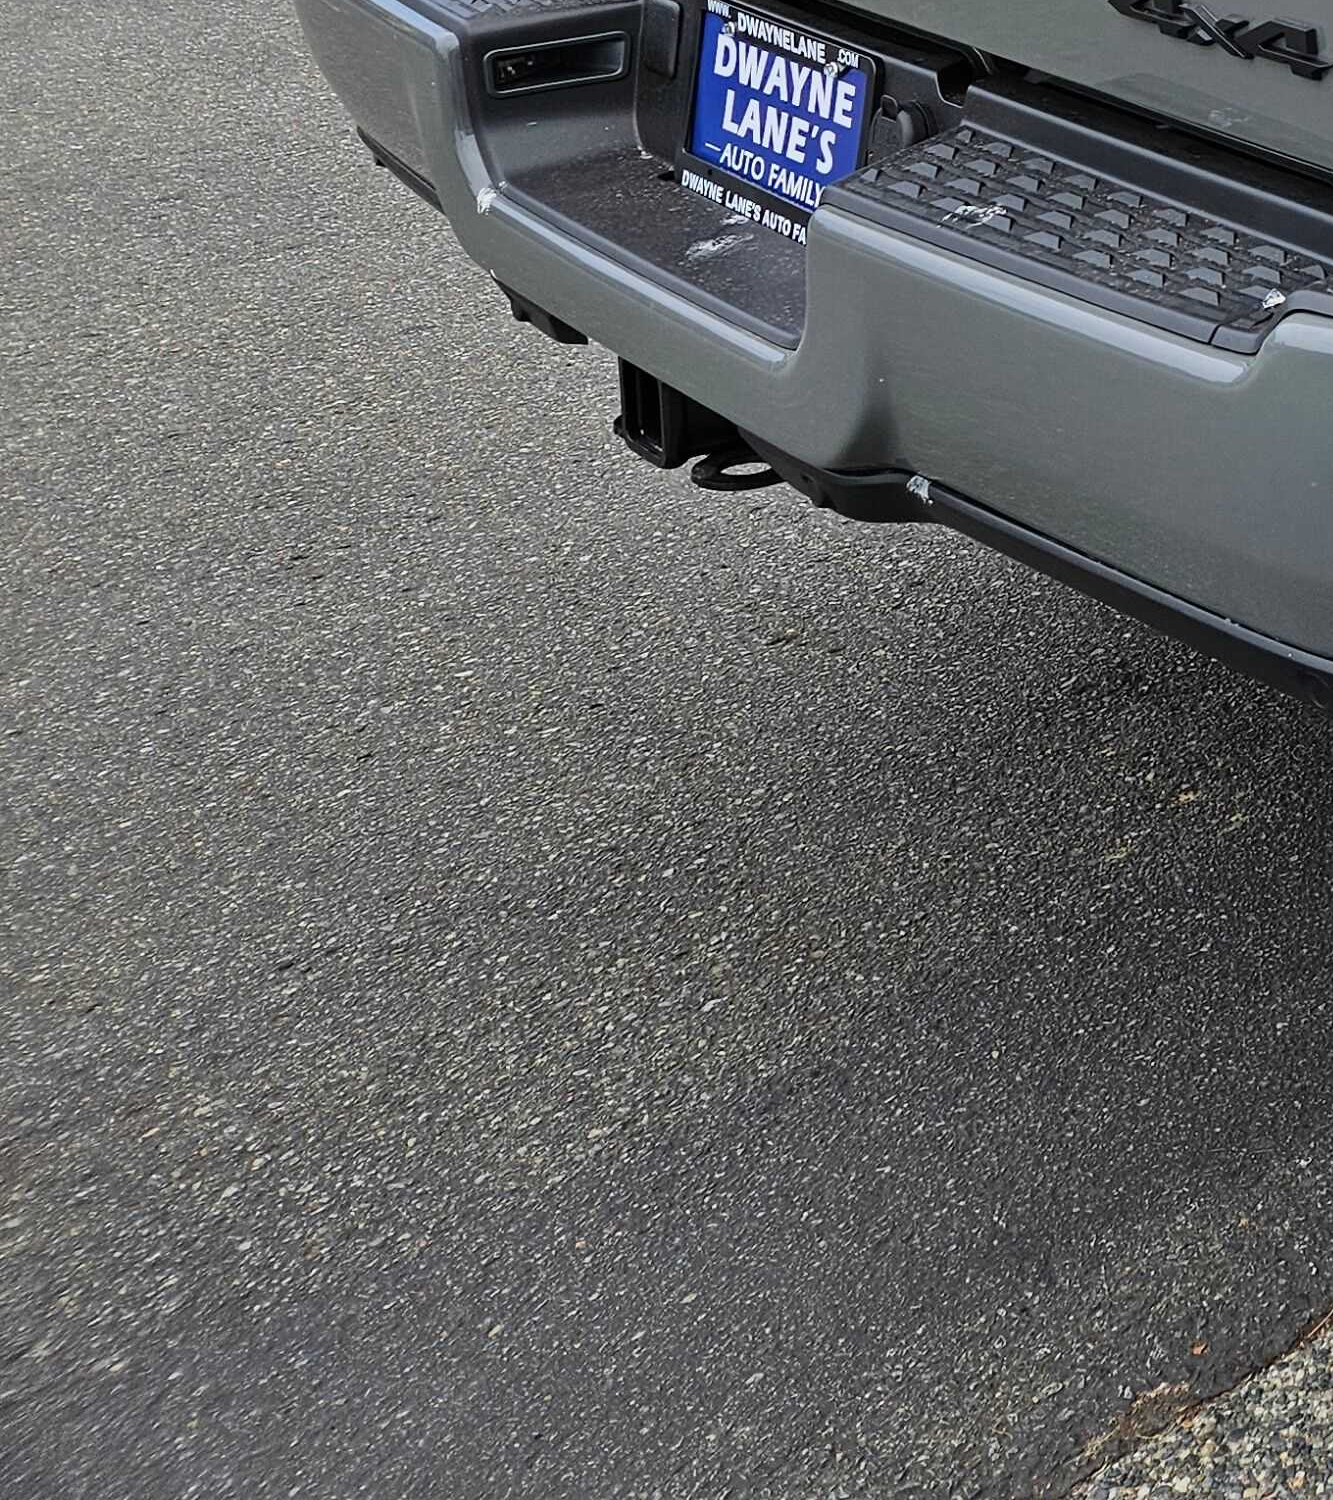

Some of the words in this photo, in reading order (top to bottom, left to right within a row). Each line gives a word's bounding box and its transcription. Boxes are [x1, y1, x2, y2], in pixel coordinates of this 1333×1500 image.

[737, 11, 826, 64] DWAYNELANE
[714, 33, 856, 128] DWAYNE
[722, 89, 836, 175] LANE'S
[681, 169, 724, 204] DWAYNE
[725, 190, 761, 222] LANE'S
[762, 208, 791, 242] AUTO
[719, 142, 765, 180] AUTO
[768, 163, 827, 208] FAMILY
